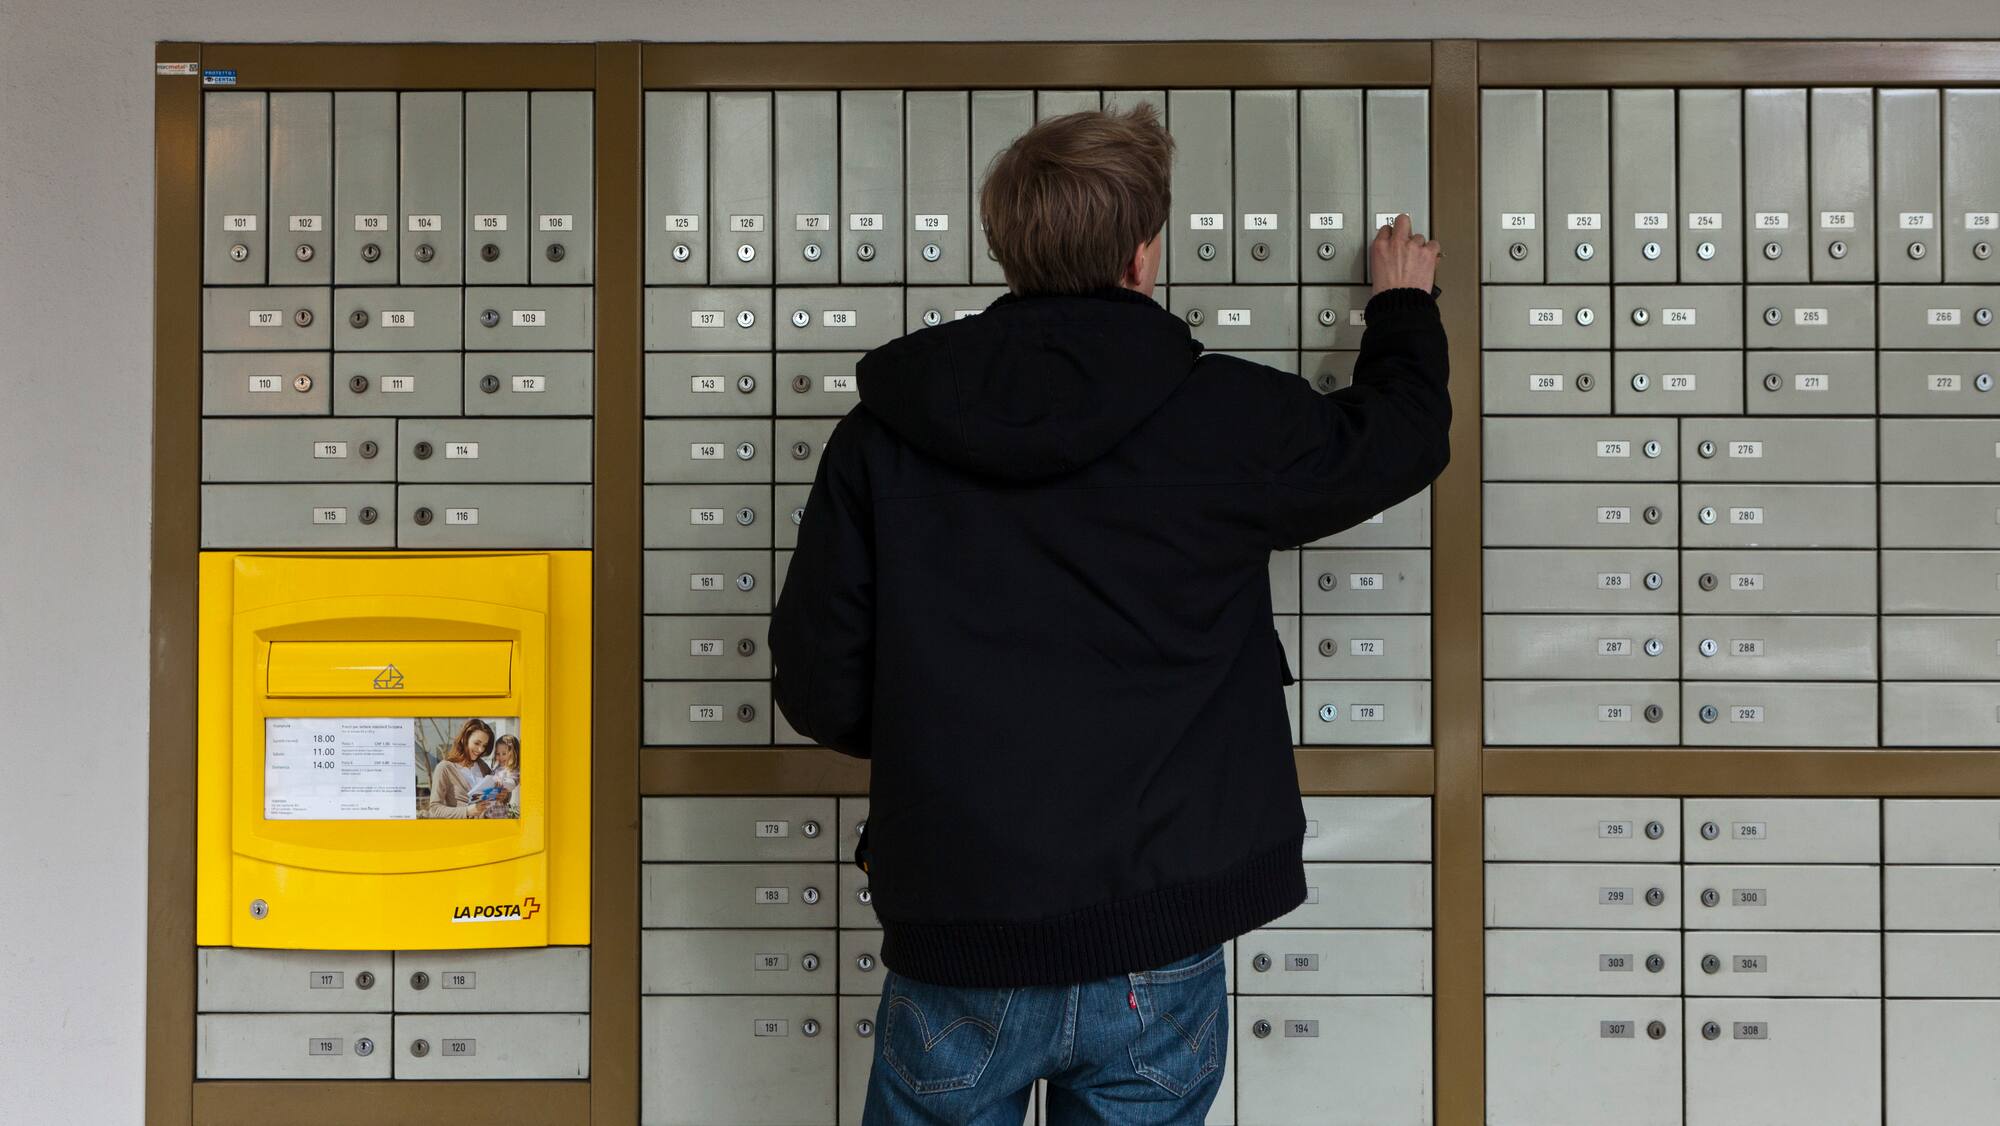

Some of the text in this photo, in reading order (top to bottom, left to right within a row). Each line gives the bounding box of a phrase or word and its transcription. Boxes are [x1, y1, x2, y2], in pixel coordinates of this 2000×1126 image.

[233, 217, 247, 228] 101
[298, 218, 313, 228] 102
[364, 217, 378, 228] 103
[417, 217, 432, 228] 104
[483, 217, 498, 228] 105
[548, 217, 563, 228] 106
[674, 218, 689, 228] 125
[739, 218, 754, 228] 126
[805, 217, 820, 228] 127
[859, 216, 874, 227] 128
[924, 217, 939, 228] 129
[1199, 216, 1214, 227] 133
[1253, 216, 1268, 227] 134
[1319, 216, 1334, 226] 135
[1511, 216, 1526, 226] 251
[1576, 216, 1592, 227] 252
[1643, 215, 1660, 226] 253
[1697, 216, 1713, 226] 254
[1763, 215, 1780, 226] 255
[1829, 214, 1846, 225] 256
[1908, 215, 1924, 226] 257
[1973, 215, 1990, 226] 258
[258, 313, 273, 323] 107
[391, 314, 406, 324] 108
[521, 313, 536, 323] 109
[700, 314, 715, 324] 137
[832, 313, 847, 324] 138
[1228, 312, 1240, 322] 141
[1537, 311, 1554, 322] 263
[1671, 311, 1687, 322] 264
[1803, 311, 1820, 322] 265
[1935, 311, 1953, 322] 266
[258, 379, 272, 389] 110
[392, 379, 403, 389] 111
[522, 378, 535, 389] 112
[701, 379, 715, 389] 143
[833, 378, 847, 389] 144
[1538, 377, 1555, 388] 269
[1671, 377, 1687, 388] 270
[1804, 377, 1820, 388] 271
[1936, 377, 1953, 388] 272
[324, 445, 337, 455] 113
[456, 445, 468, 456] 114
[700, 446, 715, 456] 149
[1605, 443, 1622, 454] 275
[1737, 444, 1754, 455] 276
[324, 510, 337, 521] 115
[456, 511, 469, 521] 116
[700, 511, 715, 522] 155
[1605, 510, 1622, 520] 279
[1738, 510, 1755, 521] 280
[700, 577, 714, 587] 161
[1359, 576, 1374, 587] 166
[1605, 575, 1622, 586] 283
[1738, 576, 1755, 587] 284
[699, 642, 714, 653] 167
[1360, 642, 1374, 653] 172
[1606, 641, 1623, 652] 287
[1738, 642, 1755, 653] 288
[699, 708, 714, 719] 173
[1360, 707, 1374, 718] 178
[1607, 708, 1622, 719] 291
[1738, 708, 1756, 719] 292
[313, 734, 336, 744] 18.00
[313, 748, 335, 757] 11.00
[312, 761, 335, 770] 14.00
[764, 824, 780, 834] 179
[1607, 824, 1624, 835] 295
[1740, 825, 1757, 836] 296
[764, 890, 780, 901] 183
[1607, 891, 1624, 901] 299
[1740, 892, 1758, 903] 300
[453, 904, 521, 919] LA POSTA
[764, 956, 779, 967] 187
[1294, 957, 1309, 969] 190
[1607, 957, 1625, 968] 303
[1741, 958, 1758, 969] 304
[320, 975, 333, 985] 117
[452, 975, 466, 985] 118
[765, 1023, 778, 1033] 191
[1294, 1023, 1309, 1033] 194
[1609, 1024, 1625, 1035] 307
[1742, 1025, 1759, 1036] 308
[320, 1041, 333, 1052] 119
[452, 1042, 466, 1052] 120
